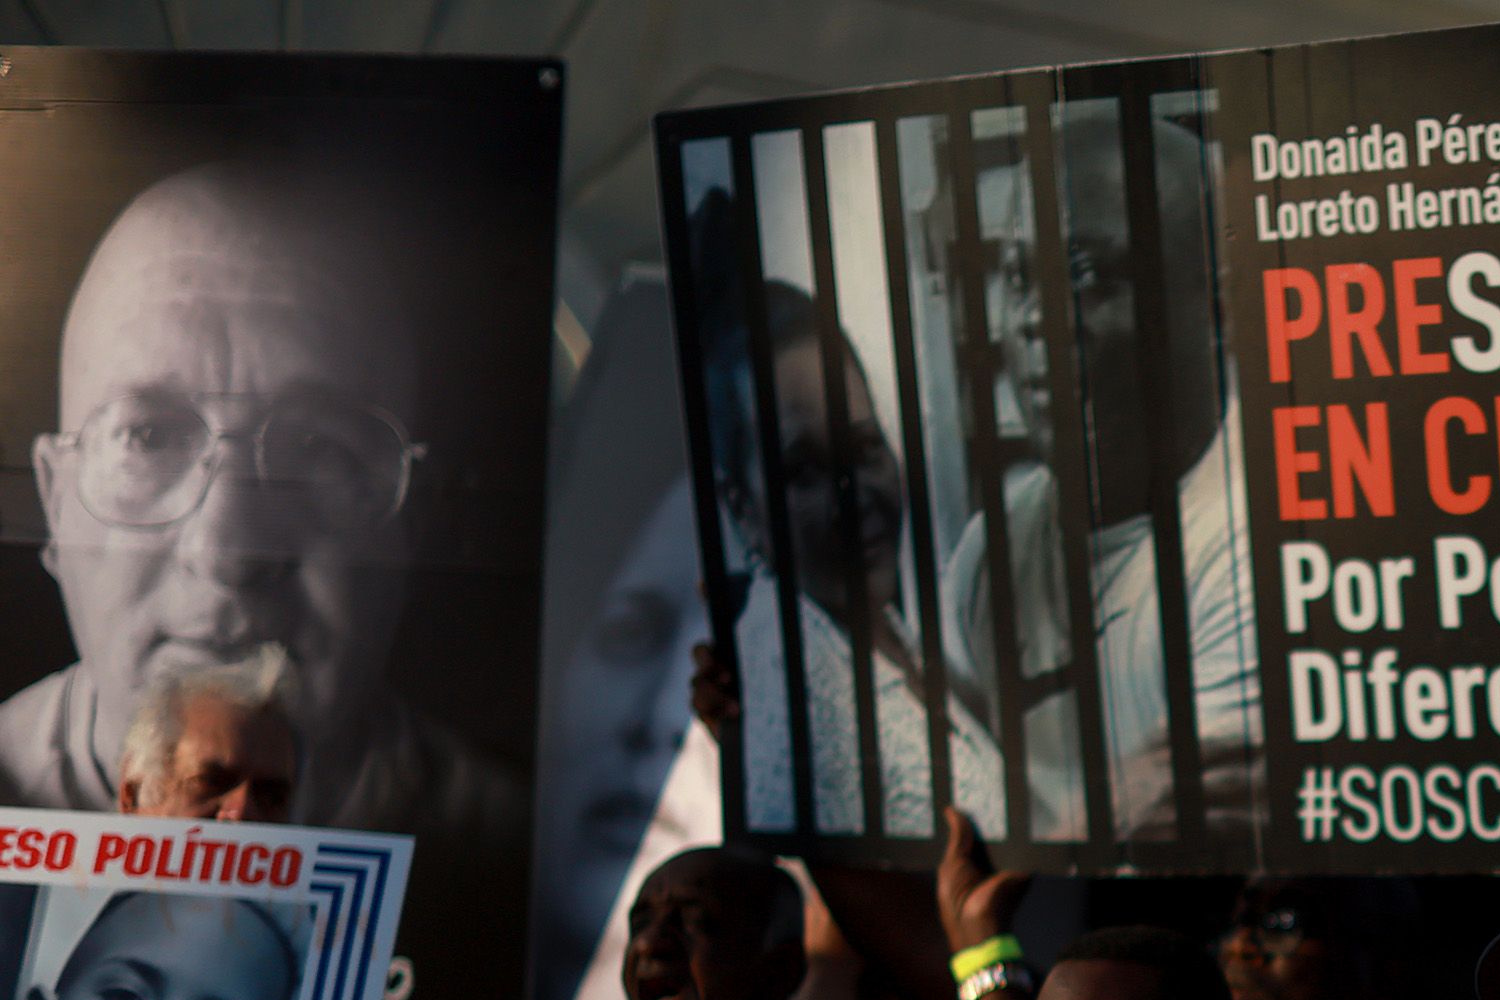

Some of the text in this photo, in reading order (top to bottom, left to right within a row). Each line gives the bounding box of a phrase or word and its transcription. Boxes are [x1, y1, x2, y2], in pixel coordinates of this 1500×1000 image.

[1250, 125, 1406, 181] Donaida
[1255, 188, 1380, 243] Loreto
[1273, 402, 1396, 521] EN
[1280, 538, 1414, 633] Por
[92, 825, 303, 888] POLÍTICO
